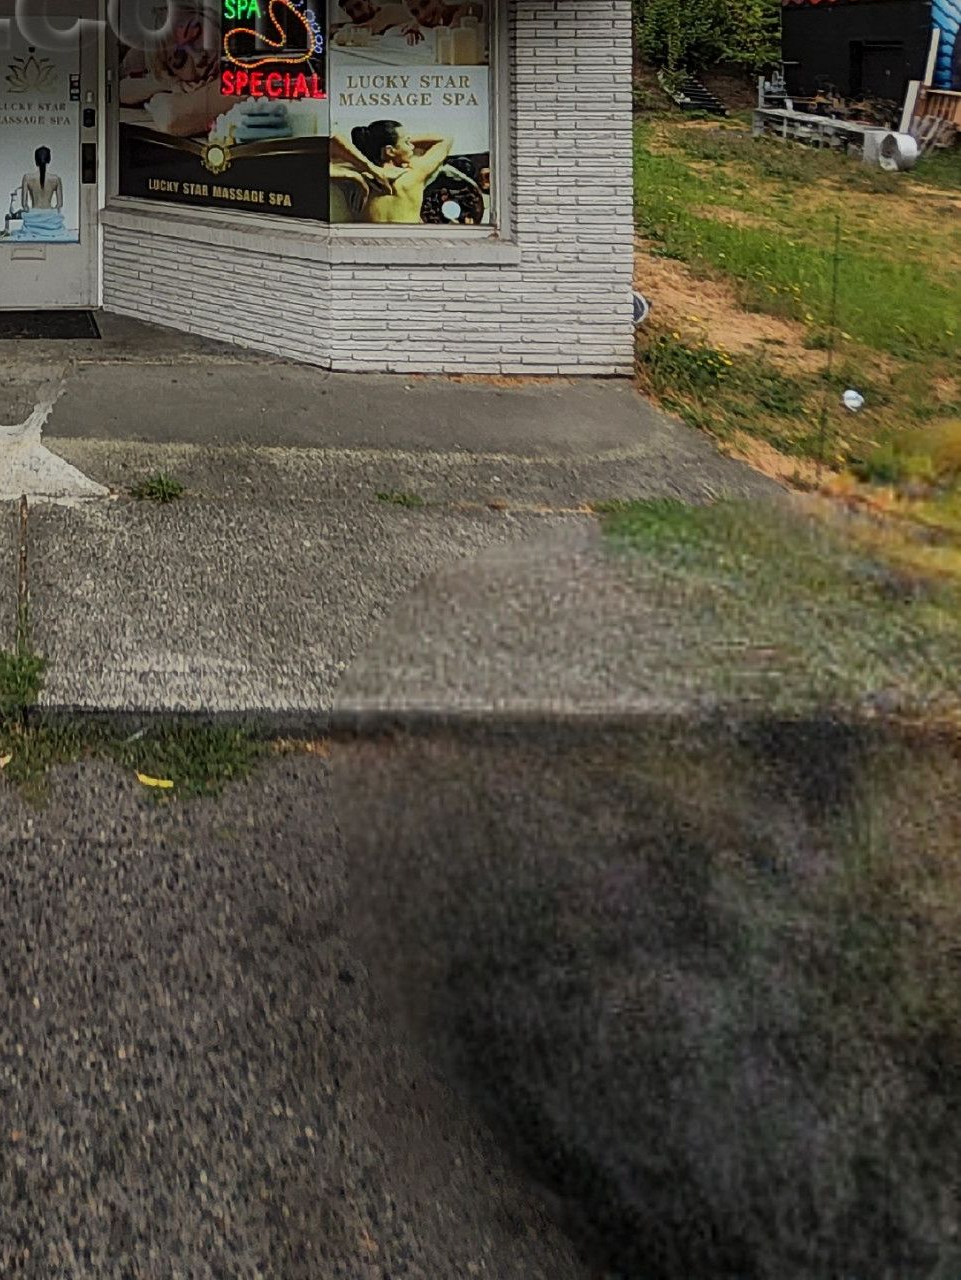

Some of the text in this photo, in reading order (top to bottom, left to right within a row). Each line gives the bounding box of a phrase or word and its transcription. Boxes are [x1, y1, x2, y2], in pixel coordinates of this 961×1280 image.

[221, 69, 328, 99] SPECIAL
[346, 75, 471, 89] LUCKY STAR
[338, 92, 480, 107] MASSAGE SPA
[38, 102, 67, 112] STAR
[50, 116, 71, 126] SPA
[148, 178, 293, 208] LUCKY STAR MASSAGE SPA
